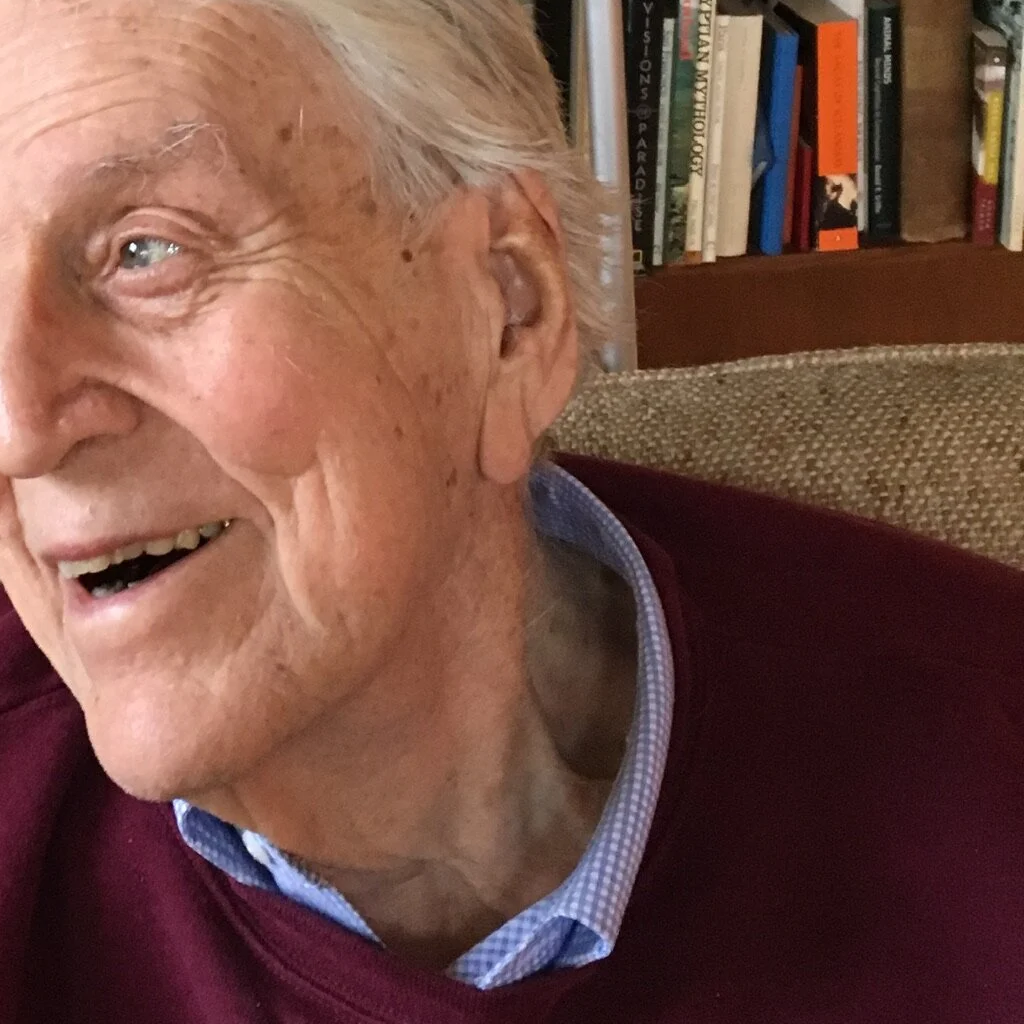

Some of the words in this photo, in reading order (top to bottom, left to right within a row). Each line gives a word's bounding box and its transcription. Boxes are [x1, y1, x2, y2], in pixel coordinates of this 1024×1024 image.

[639, 2, 654, 100] VISIONS
[882, 16, 892, 53] ANIMAL
[882, 54, 892, 85] MINDS
[690, 69, 710, 177] MYTHOLOGY
